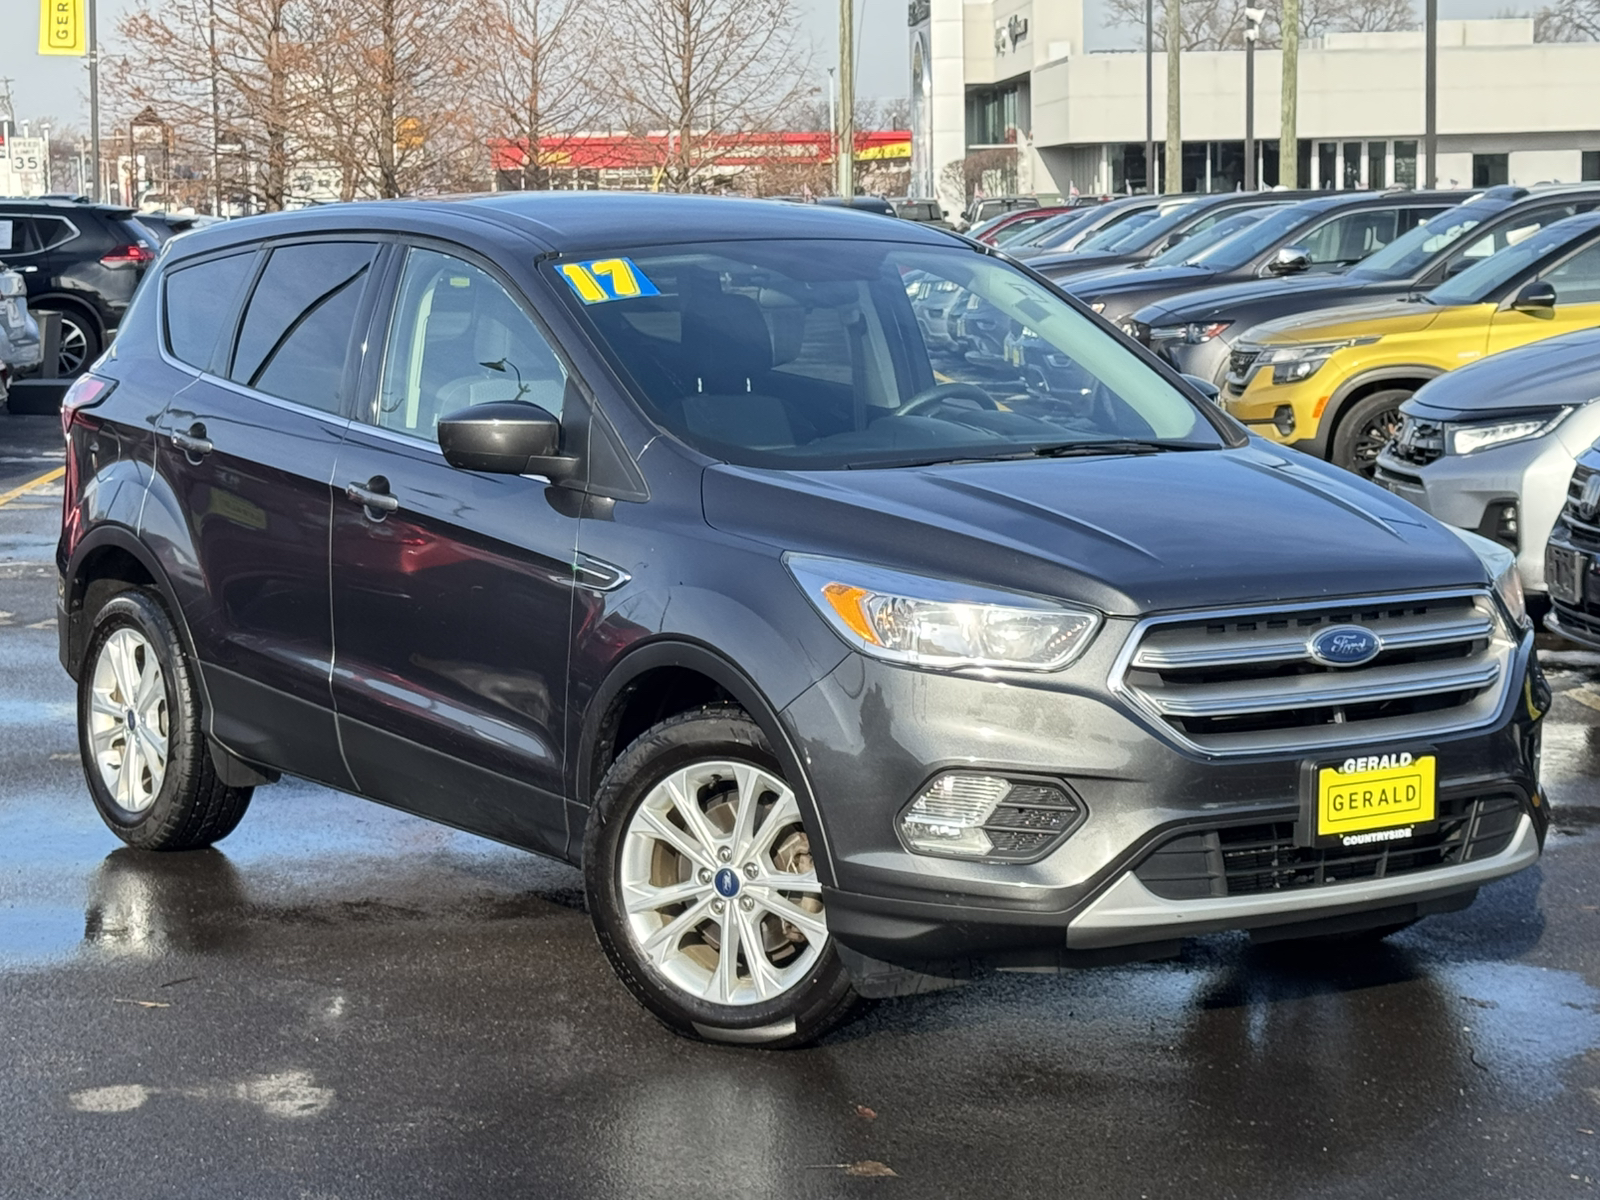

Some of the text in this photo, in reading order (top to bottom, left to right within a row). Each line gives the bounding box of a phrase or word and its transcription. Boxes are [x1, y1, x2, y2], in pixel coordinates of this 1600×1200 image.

[56, 2, 69, 40] GER
[15, 156, 38, 169] 35
[562, 257, 642, 302] 17
[1330, 634, 1368, 654] Ford
[1342, 752, 1413, 774] GERALD
[1332, 784, 1417, 812] GERALD
[1342, 827, 1413, 847] COUNTRYSIDE
